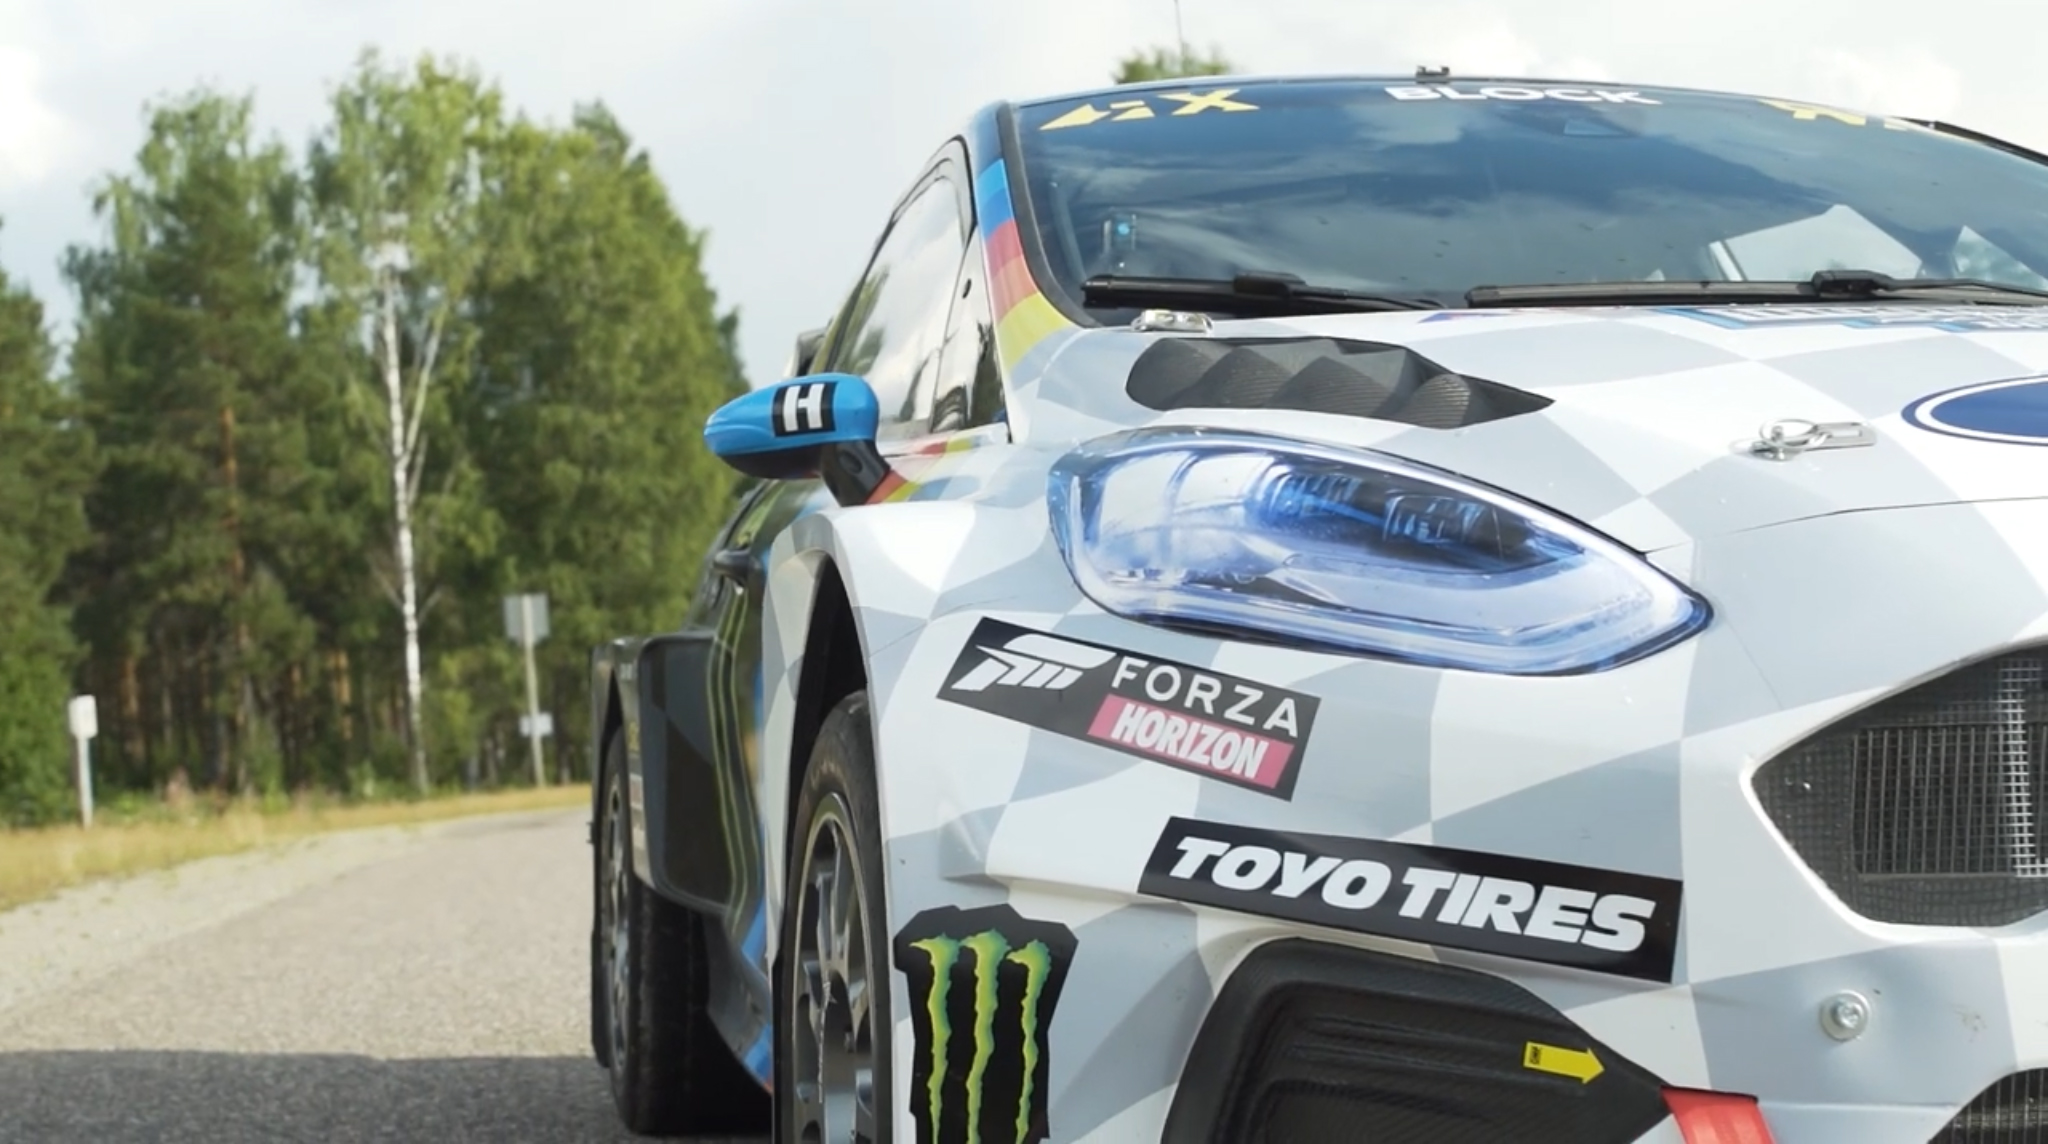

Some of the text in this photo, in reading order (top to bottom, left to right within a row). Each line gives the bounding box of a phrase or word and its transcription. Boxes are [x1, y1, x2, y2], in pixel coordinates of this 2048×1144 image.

[1385, 86, 1663, 105] BLOCK
[783, 383, 825, 432] H
[1111, 656, 1299, 738] FORZA
[1110, 701, 1268, 779] HORIZON
[1168, 836, 1657, 952] TOYO TIRES
